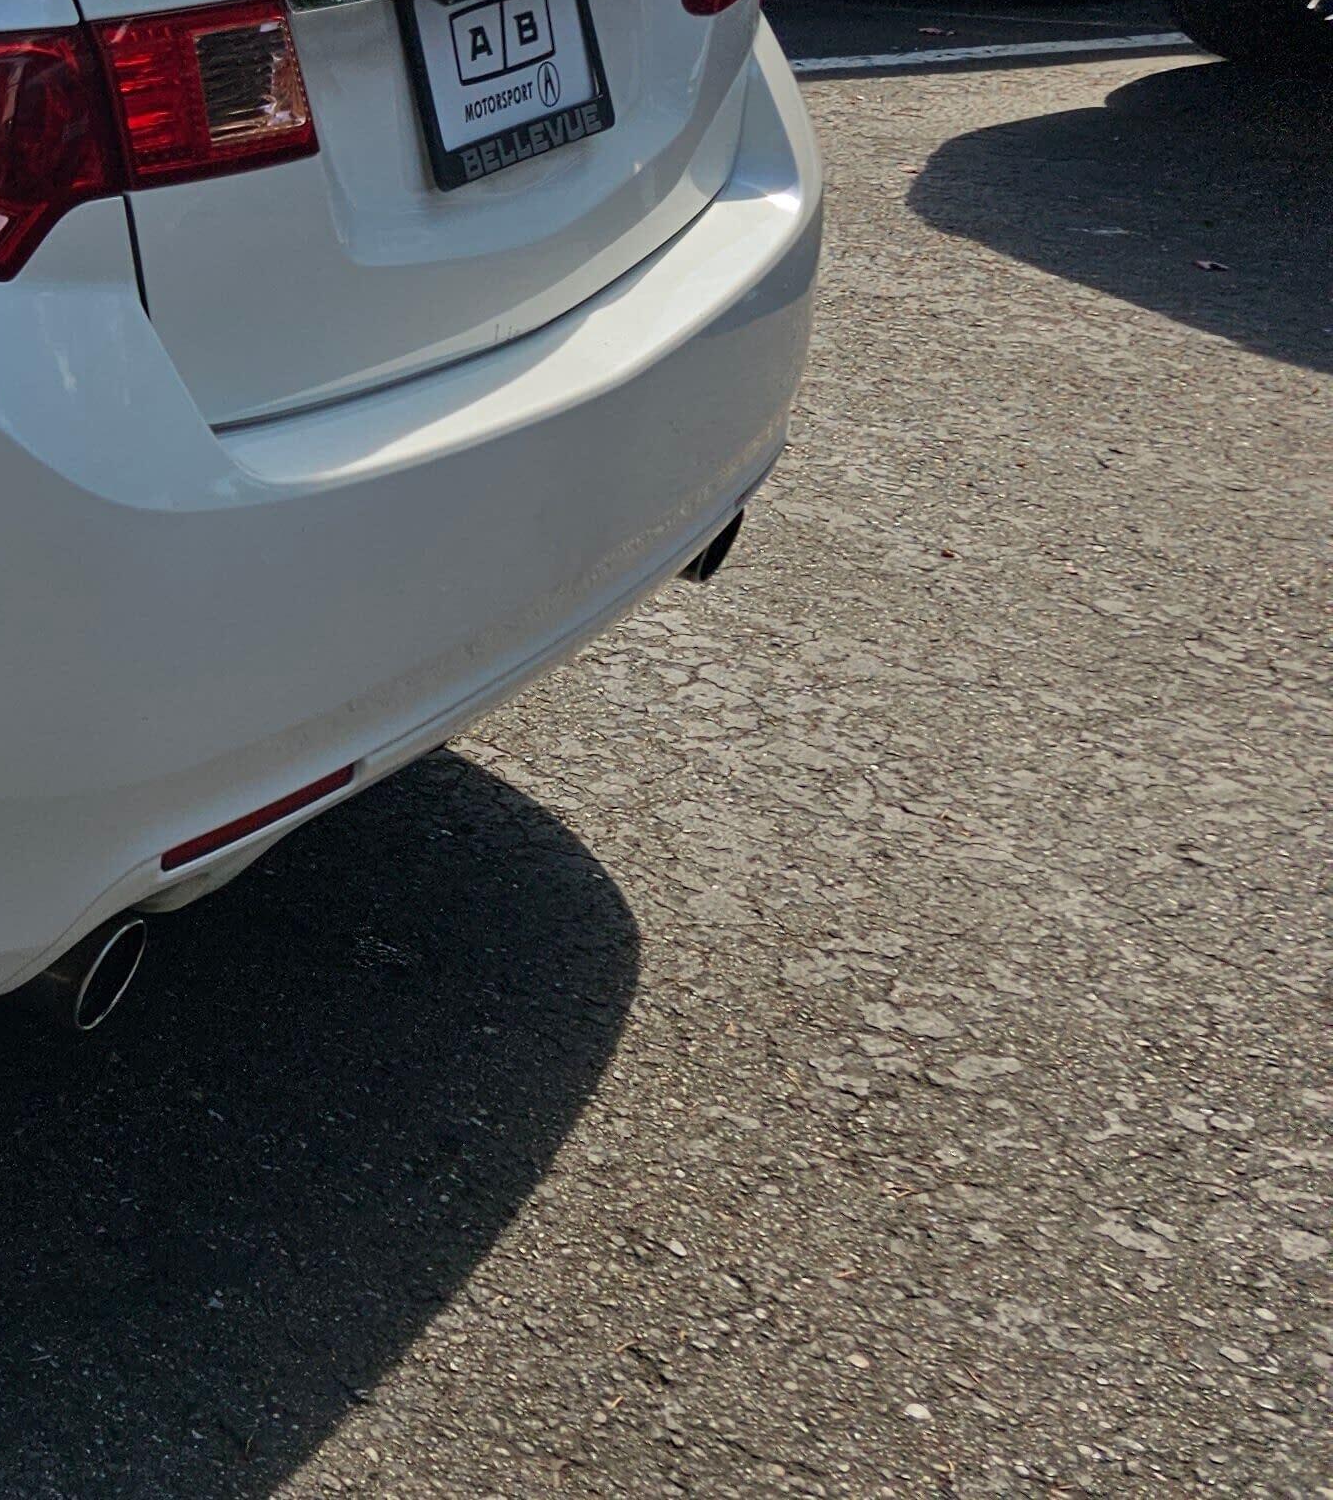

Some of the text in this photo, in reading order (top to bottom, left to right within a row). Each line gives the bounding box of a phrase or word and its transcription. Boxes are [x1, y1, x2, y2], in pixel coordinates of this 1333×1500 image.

[468, 10, 539, 62] A B
[464, 81, 534, 123] MOTORSPORT
[460, 103, 603, 181] BELLEVUE
